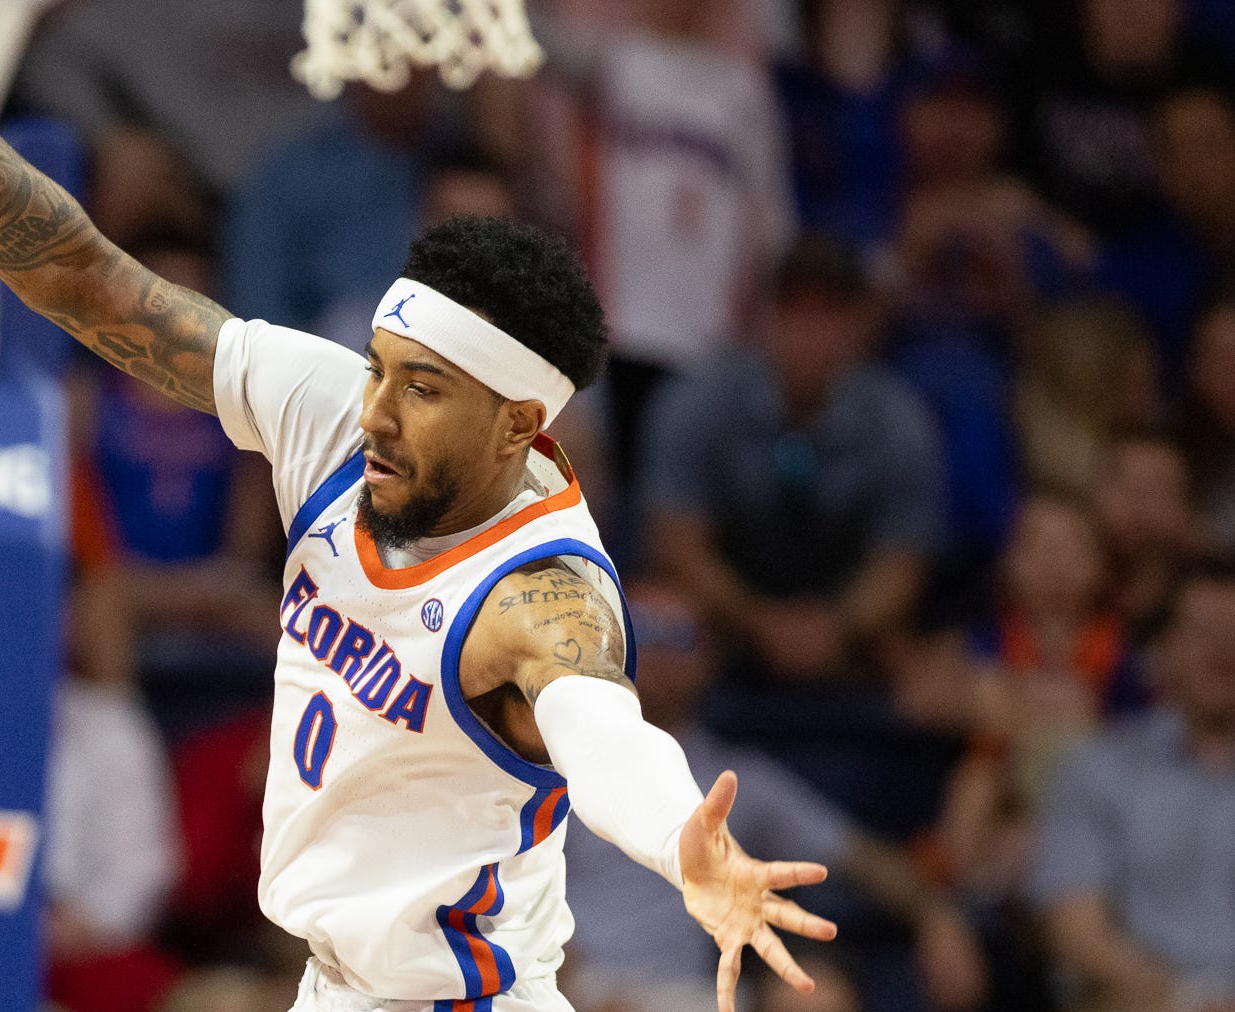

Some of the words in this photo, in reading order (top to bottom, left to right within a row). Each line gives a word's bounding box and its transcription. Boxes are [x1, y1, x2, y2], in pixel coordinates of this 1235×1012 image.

[281, 563, 434, 734] FLORIDA
[422, 599, 443, 631] SEC
[292, 690, 338, 791] 0
